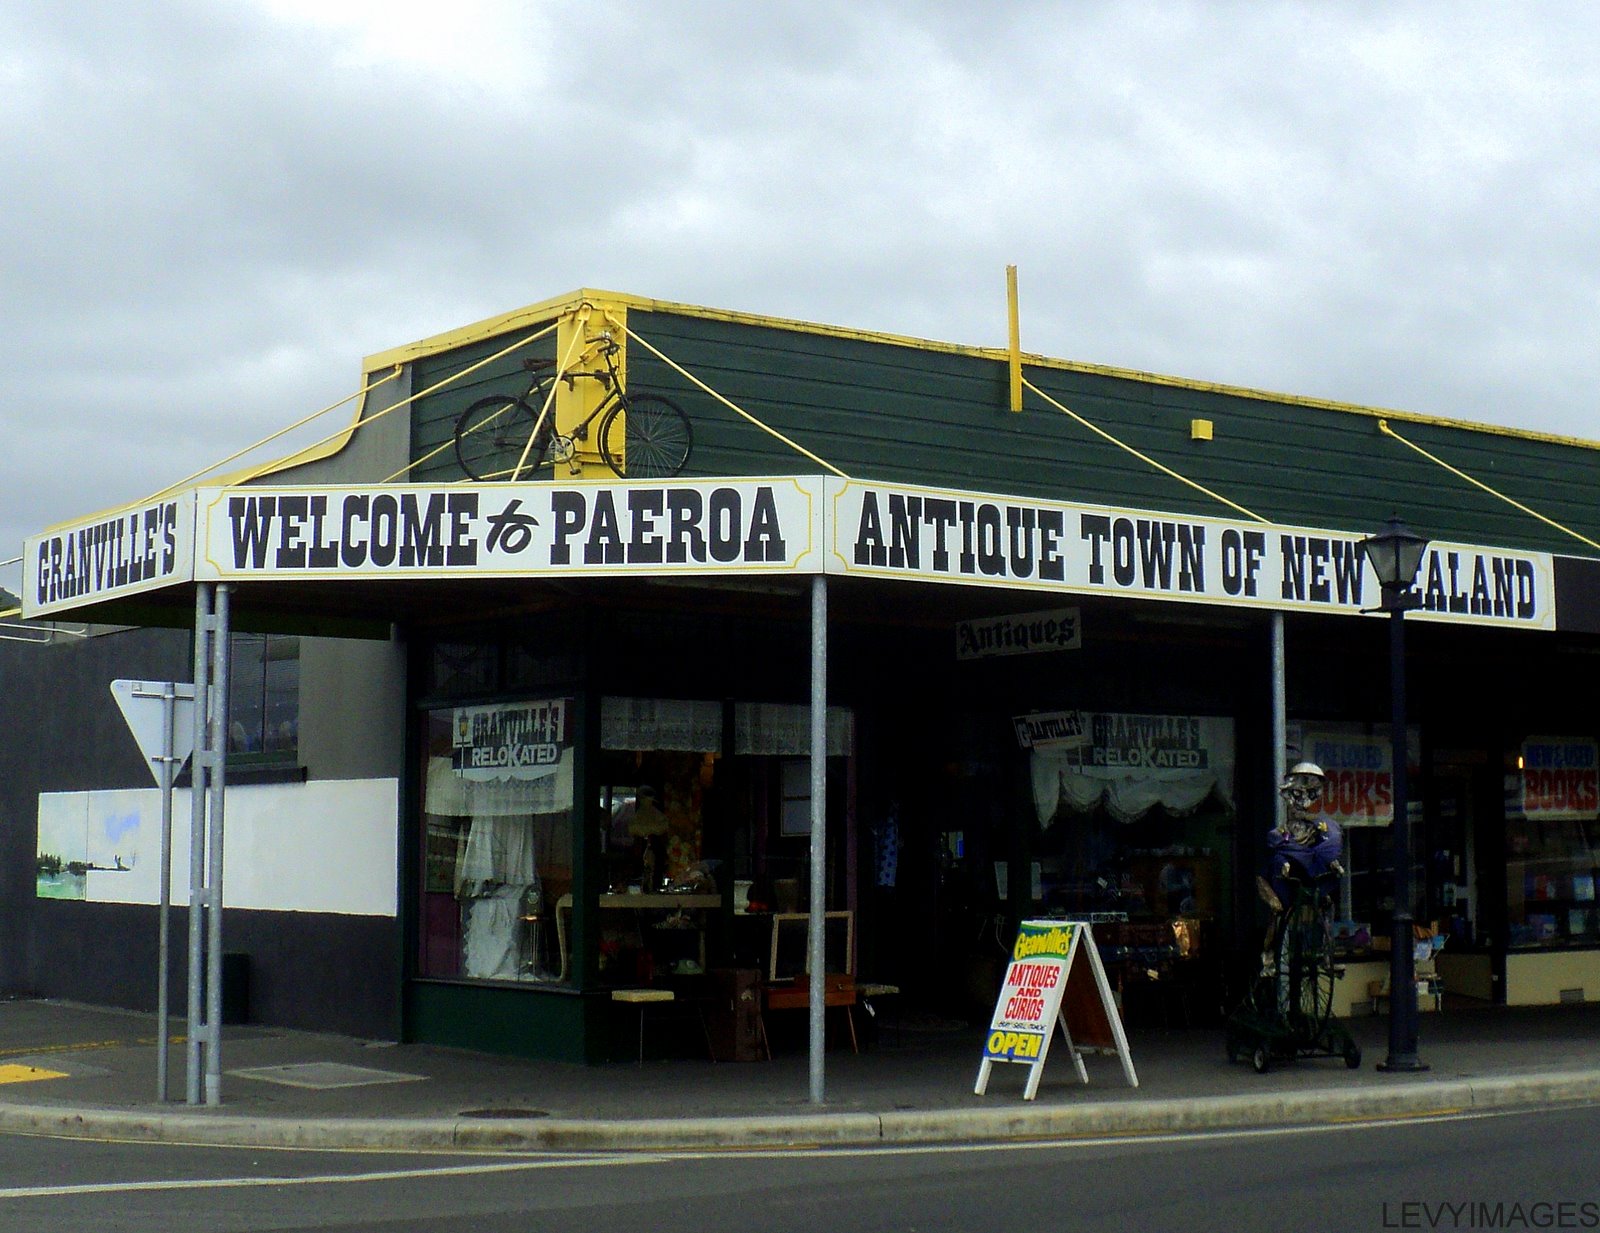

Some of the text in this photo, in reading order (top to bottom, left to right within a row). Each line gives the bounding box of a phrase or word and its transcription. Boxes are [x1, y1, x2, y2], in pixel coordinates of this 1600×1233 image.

[228, 486, 786, 570] WELCOME to PAEROA
[36, 502, 178, 605] GRANVILLE'S
[853, 491, 1536, 620] ANTIQUE TOWN OF NEW ALAND
[959, 617, 1075, 655] Antiques
[471, 701, 561, 746] GRANVILLE'S
[1014, 708, 1083, 749] GRANVILLE'S
[471, 740, 558, 769] RELOKATED
[1091, 747, 1201, 768] RELOKATED
[1305, 769, 1391, 816] OOKS
[1524, 769, 1598, 811] BOOKS
[1008, 964, 1060, 988] ANTIQUES
[1016, 987, 1042, 998] AND
[1005, 997, 1045, 1021] CURIOS
[988, 1031, 1043, 1057] OPEN
